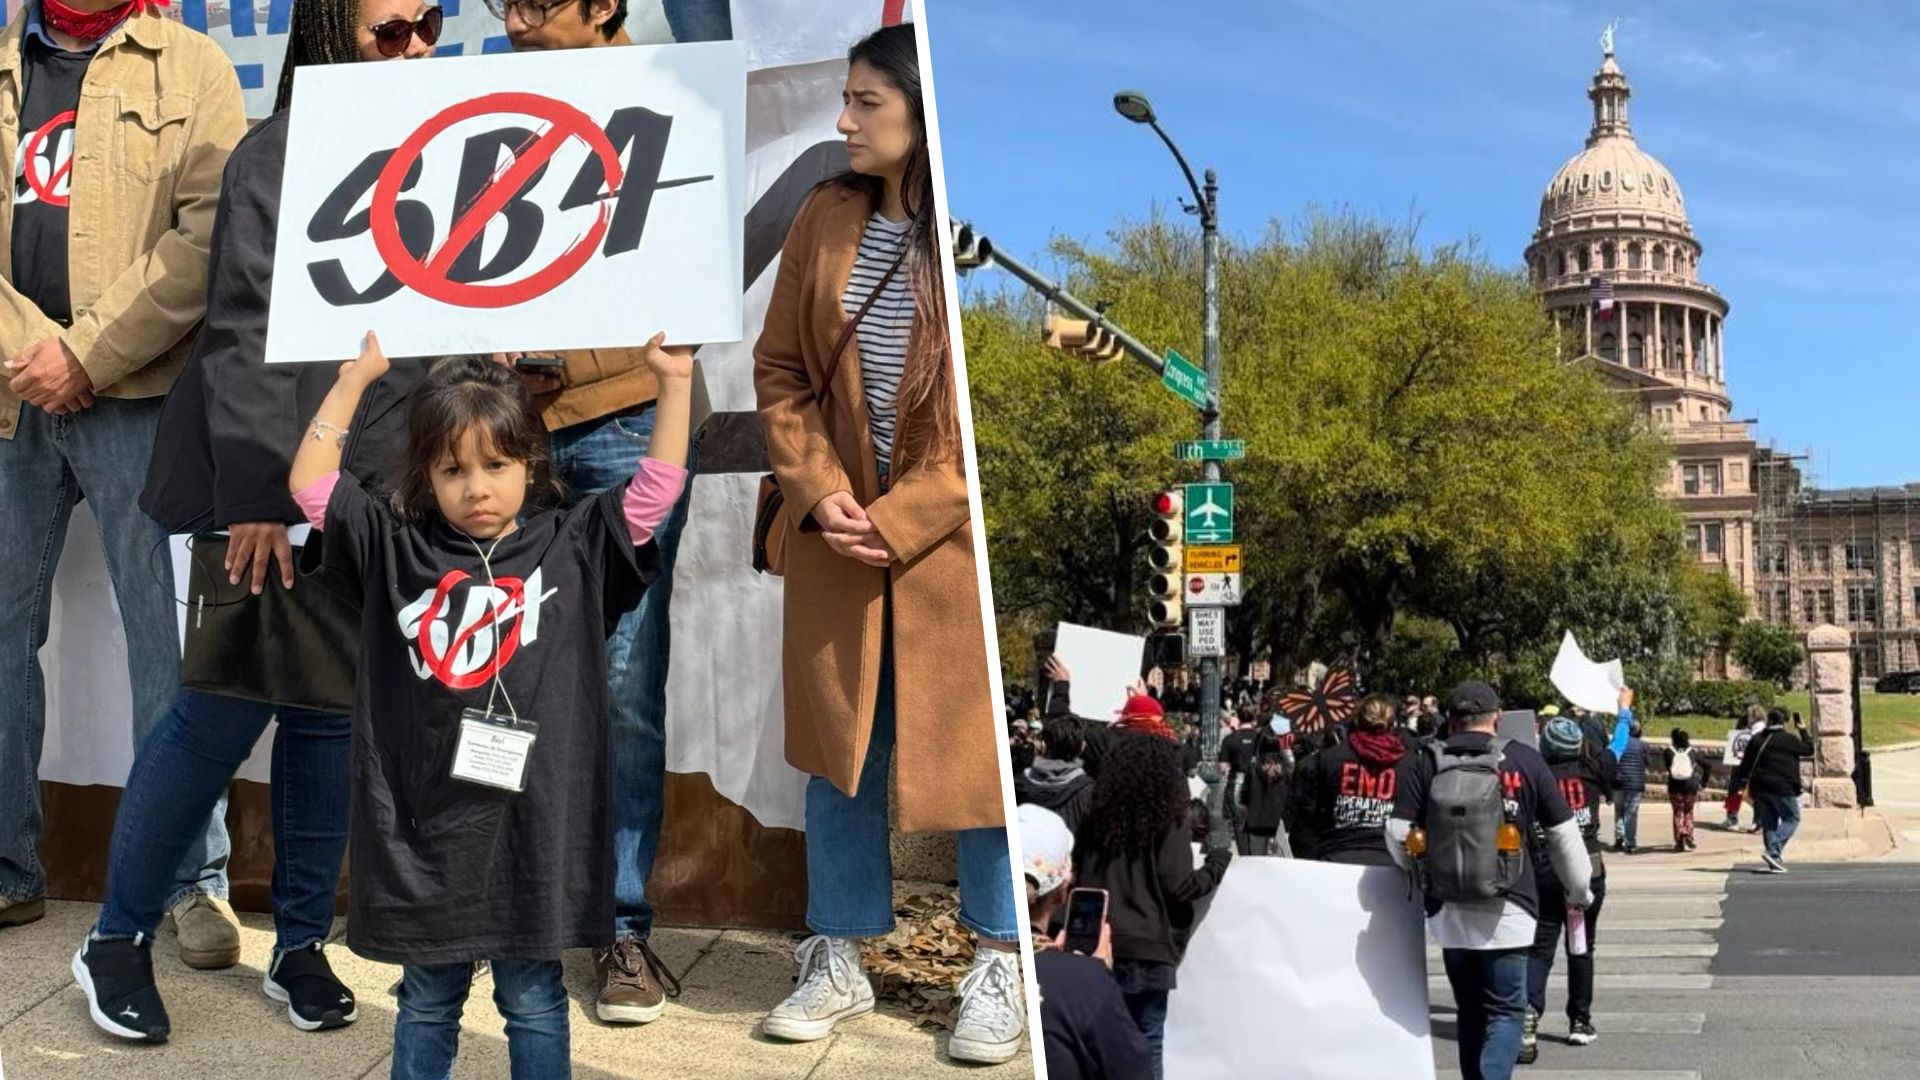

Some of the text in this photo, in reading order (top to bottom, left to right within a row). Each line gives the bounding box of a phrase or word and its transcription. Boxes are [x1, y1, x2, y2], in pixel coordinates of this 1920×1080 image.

[1189, 561, 1223, 569] VEHICLES
[1195, 611, 1218, 619] BIKES
[1198, 636, 1215, 644] PED
[1341, 763, 1396, 799] END
[1336, 795, 1395, 812] OPERATION
